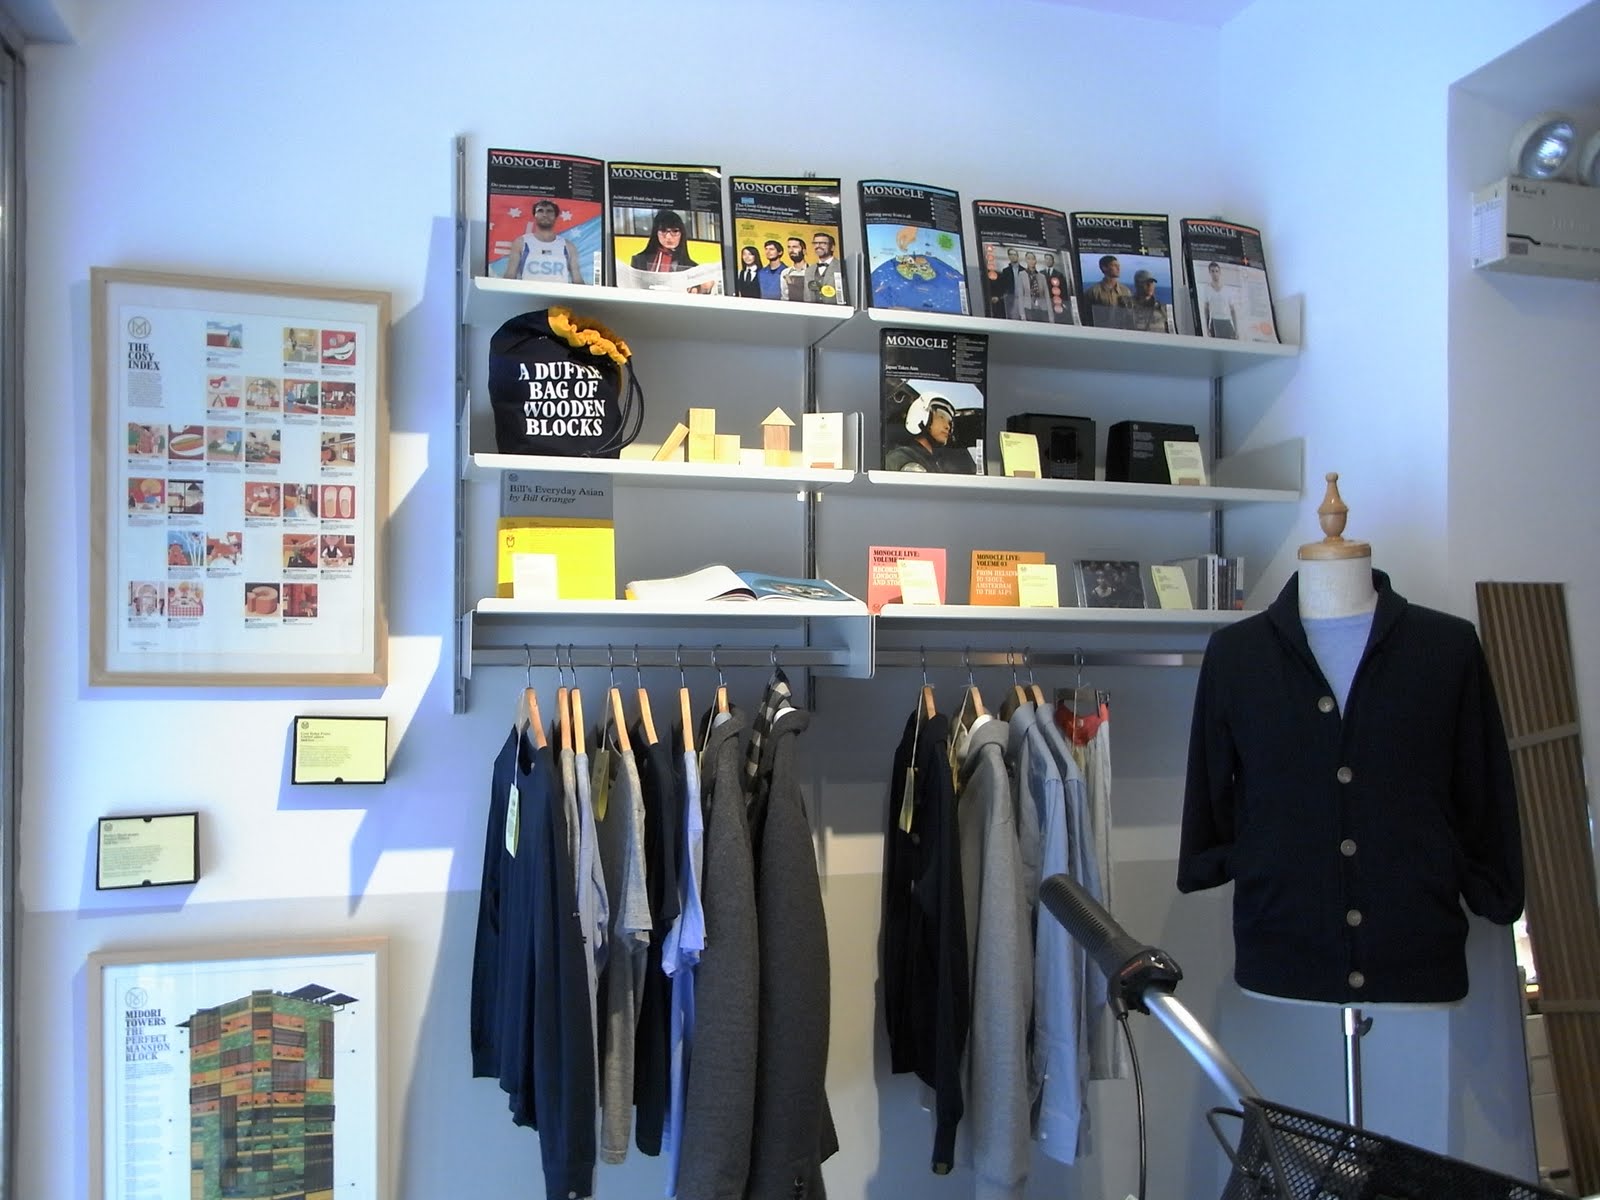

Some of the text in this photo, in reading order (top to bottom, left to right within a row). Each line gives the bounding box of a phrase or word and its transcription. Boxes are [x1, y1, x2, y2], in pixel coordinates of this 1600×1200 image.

[491, 155, 561, 169] MONOCLE
[611, 168, 678, 180] MONOCLE
[734, 182, 798, 195] MONOCLE
[864, 186, 924, 199] MONOCLE
[978, 206, 1035, 219] MONOCLE
[1076, 218, 1134, 228] MONOCLE
[1188, 224, 1237, 238] MONOCLE
[527, 261, 565, 275] CSR
[128, 342, 149, 352] THE
[886, 336, 948, 349] MONOCLE
[128, 352, 154, 362] COSY
[128, 360, 160, 370] INDEX
[518, 364, 530, 380] A
[529, 380, 598, 400] BAG OF
[524, 400, 605, 418] WOODEN
[526, 418, 603, 436] BLOCKS
[510, 485, 604, 496] Bill's Everyday Asian
[510, 494, 576, 504] by Bill Granger
[126, 1009, 161, 1018] MIDORI
[126, 1018, 166, 1028] TOWERS
[126, 1026, 143, 1036] THE
[126, 1034, 167, 1044] PERFECT
[126, 1044, 170, 1053] MANSION
[126, 1052, 158, 1062] BLOCK
